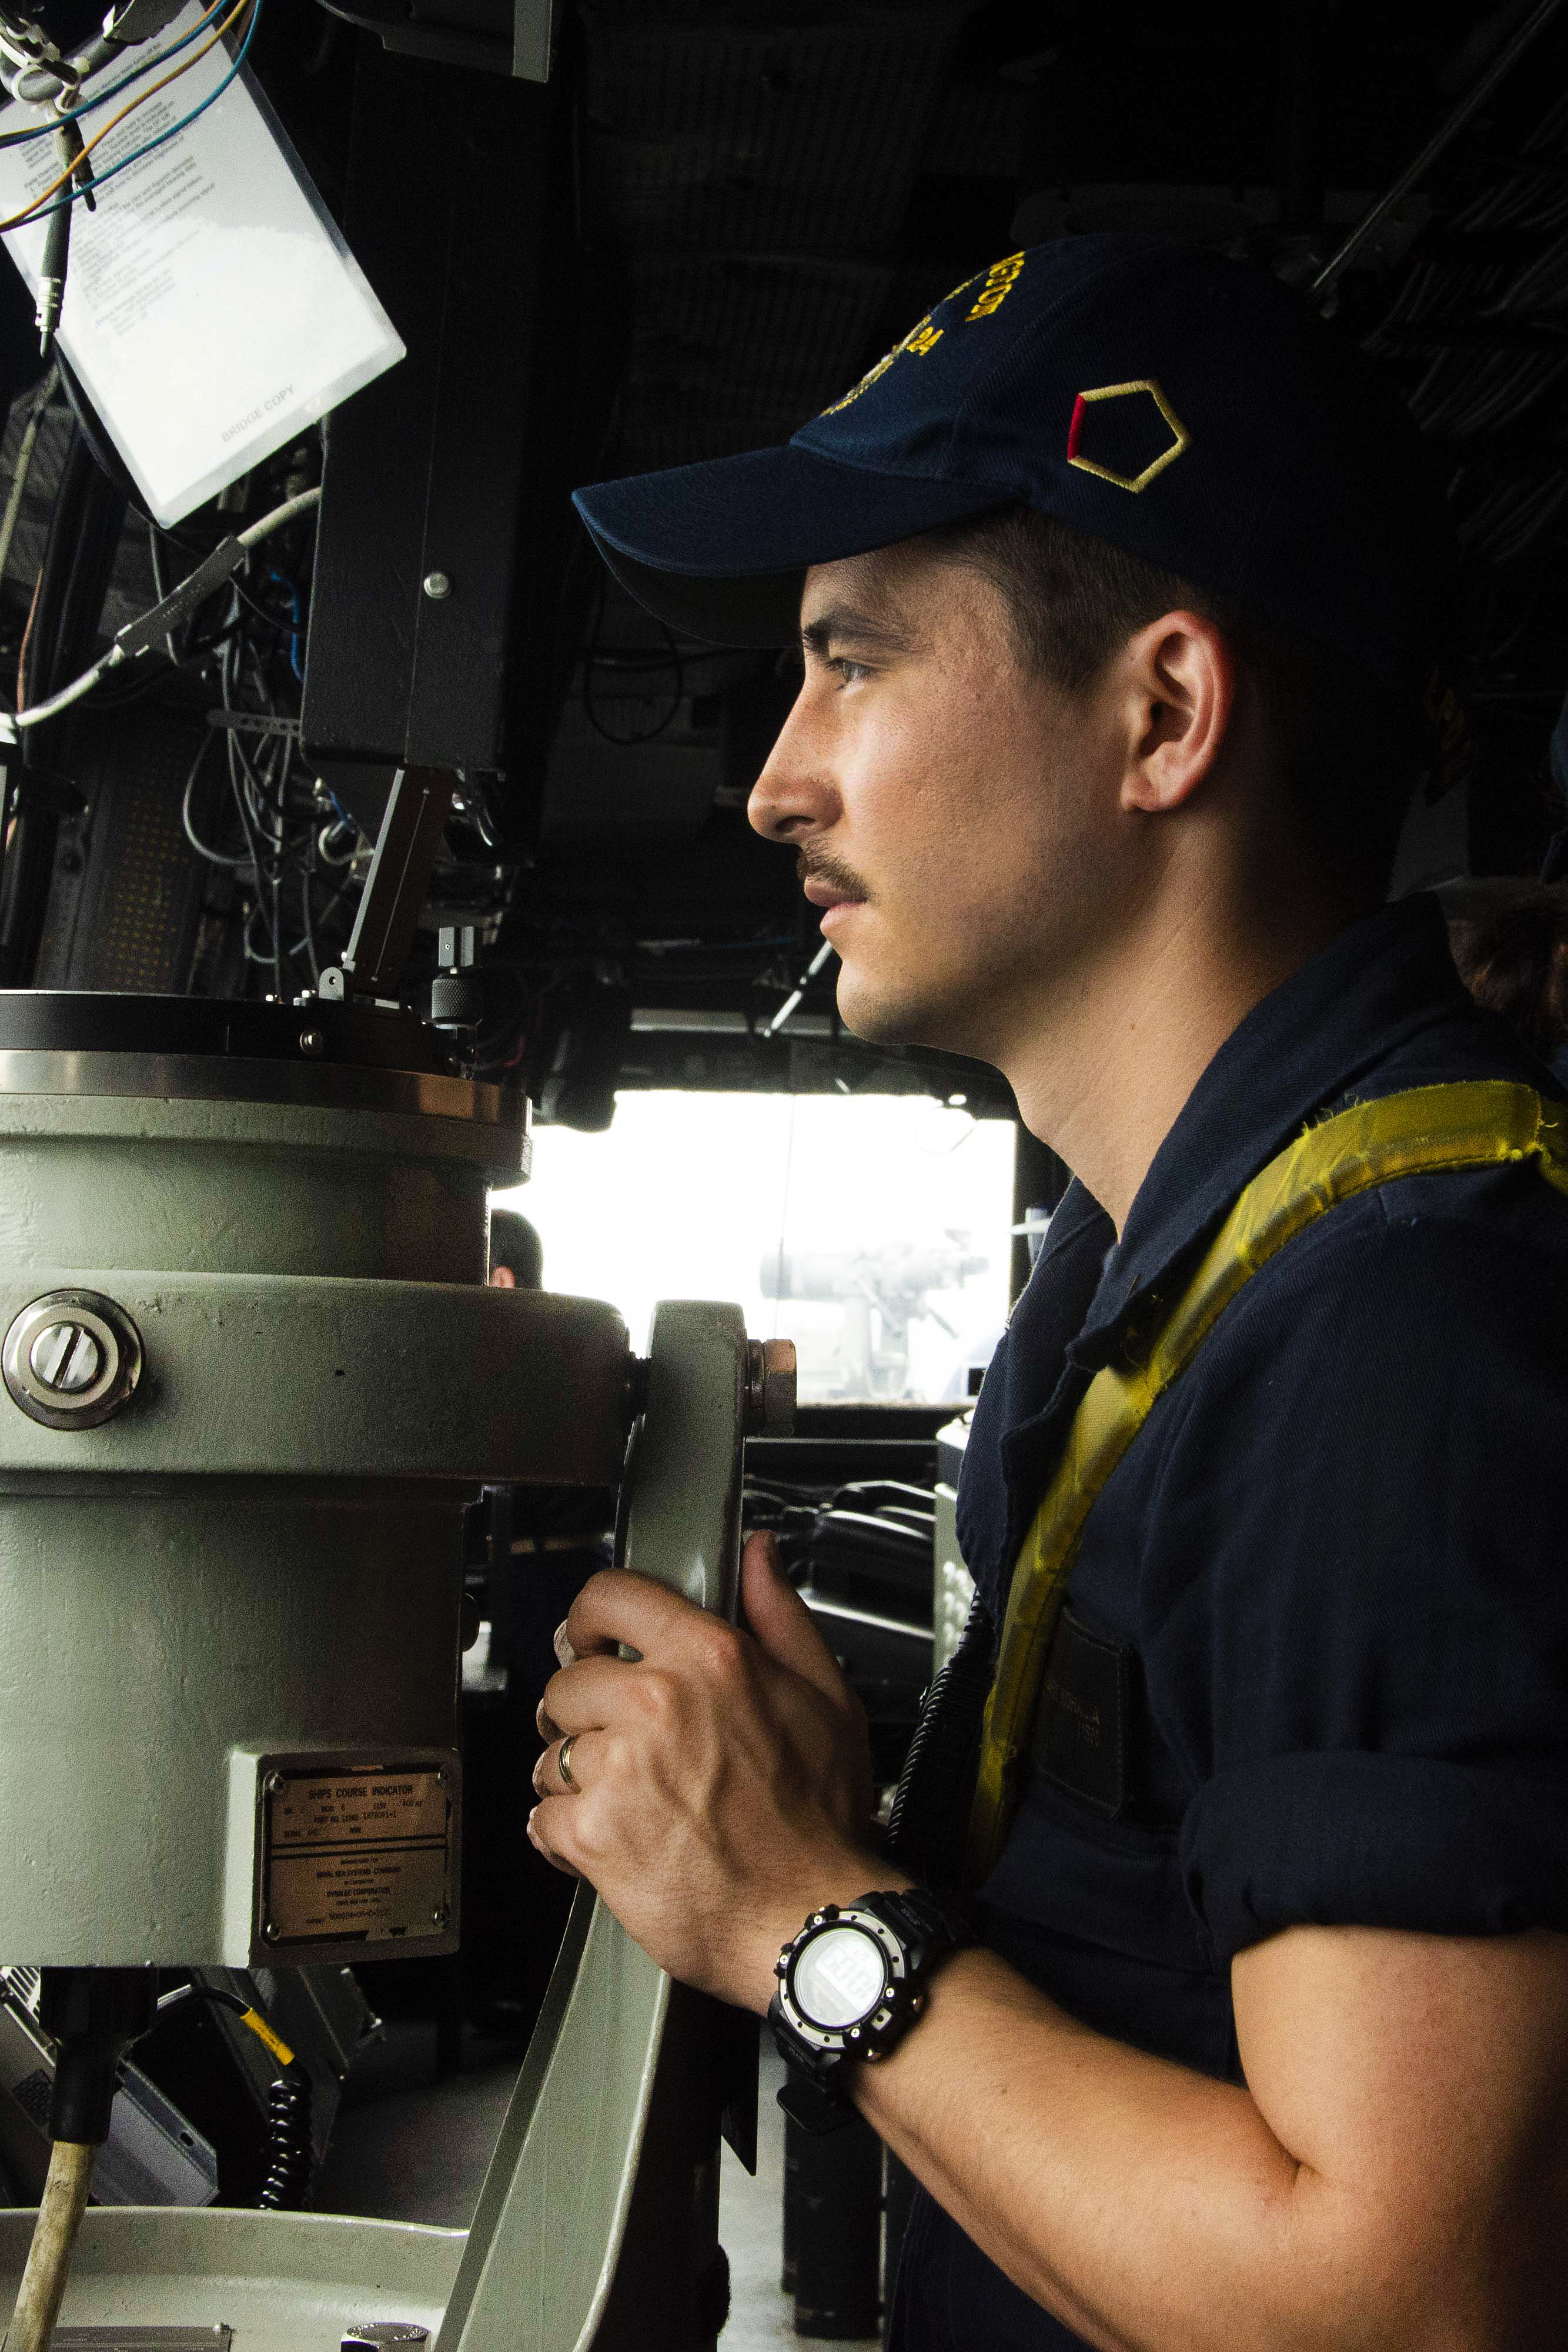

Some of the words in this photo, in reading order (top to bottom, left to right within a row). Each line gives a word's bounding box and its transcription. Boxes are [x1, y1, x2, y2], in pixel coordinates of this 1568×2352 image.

[221, 407, 263, 443] BRIDGE
[264, 383, 295, 412] COPY
[309, 1789, 332, 1800] SHIPS
[336, 1787, 367, 1798] COURSE
[372, 1785, 414, 1796] INDICATOR
